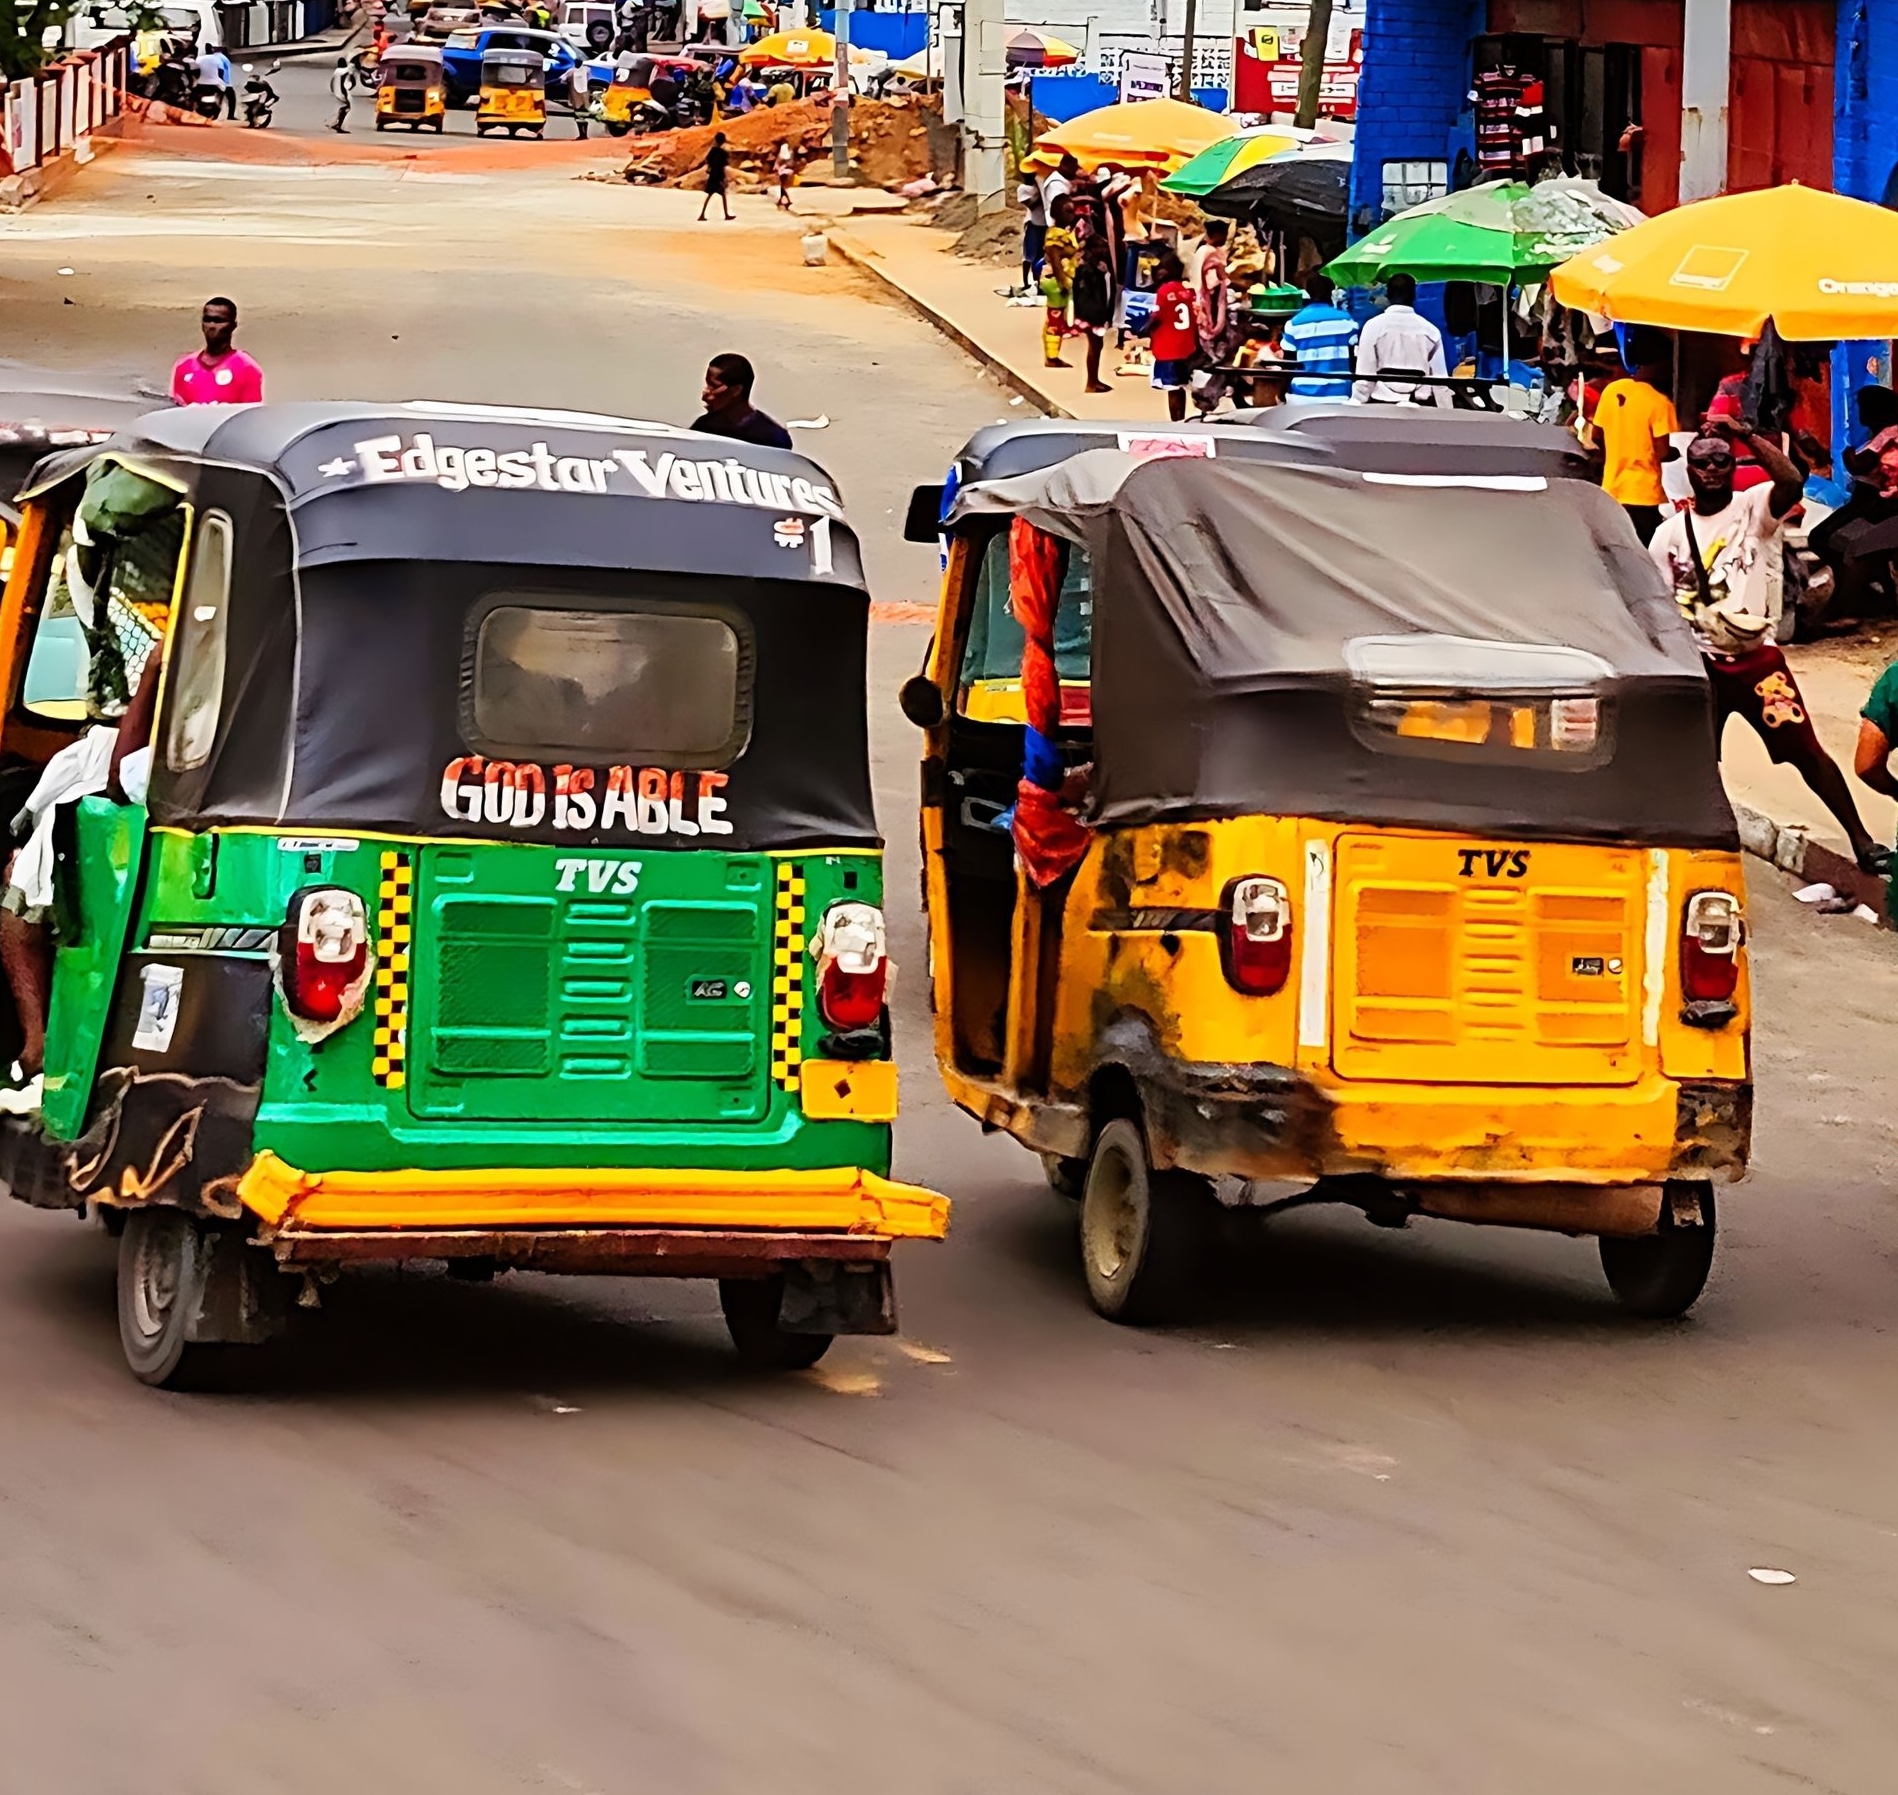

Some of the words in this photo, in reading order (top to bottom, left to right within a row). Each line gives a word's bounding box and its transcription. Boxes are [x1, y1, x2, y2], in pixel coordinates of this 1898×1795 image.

[1174, 303, 1190, 330] 3
[354, 433, 617, 493] Edgestar
[613, 449, 845, 517] Ventures
[774, 514, 834, 575] #1
[440, 755, 546, 828] GOD
[552, 764, 596, 830] IS
[601, 765, 734, 836] ABLE
[555, 858, 642, 894] TVS
[1458, 848, 1531, 878] TVS
